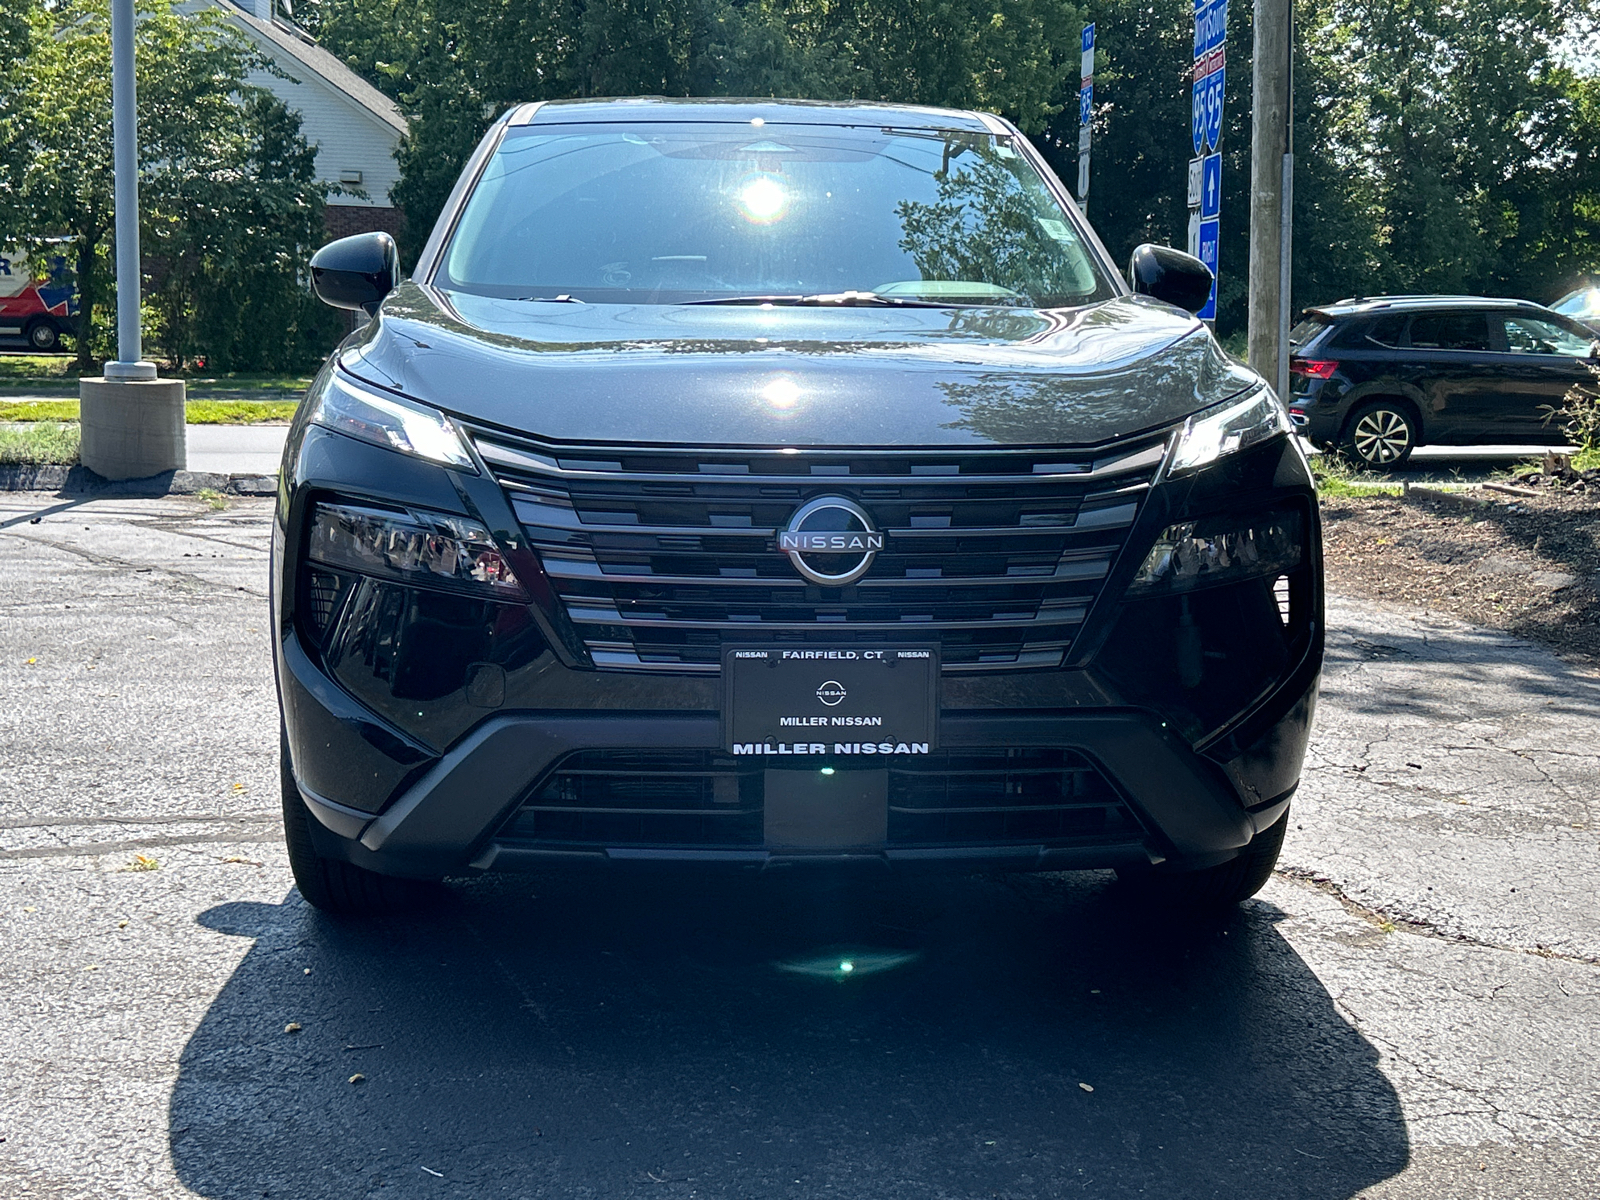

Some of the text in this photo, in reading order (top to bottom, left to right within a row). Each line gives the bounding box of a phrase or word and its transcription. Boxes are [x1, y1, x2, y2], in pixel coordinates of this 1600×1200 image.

[1082, 92, 1091, 116] 95
[1208, 82, 1222, 131] 95
[1194, 90, 1206, 135] 95
[782, 535, 883, 549] NISSAN
[735, 651, 768, 659] NISSAN
[782, 651, 884, 661] FAIRFIELD, CT
[897, 651, 930, 659] NISSAN
[780, 716, 882, 727] MILLER NISSAN
[733, 743, 929, 755] MILLER NISSAN
